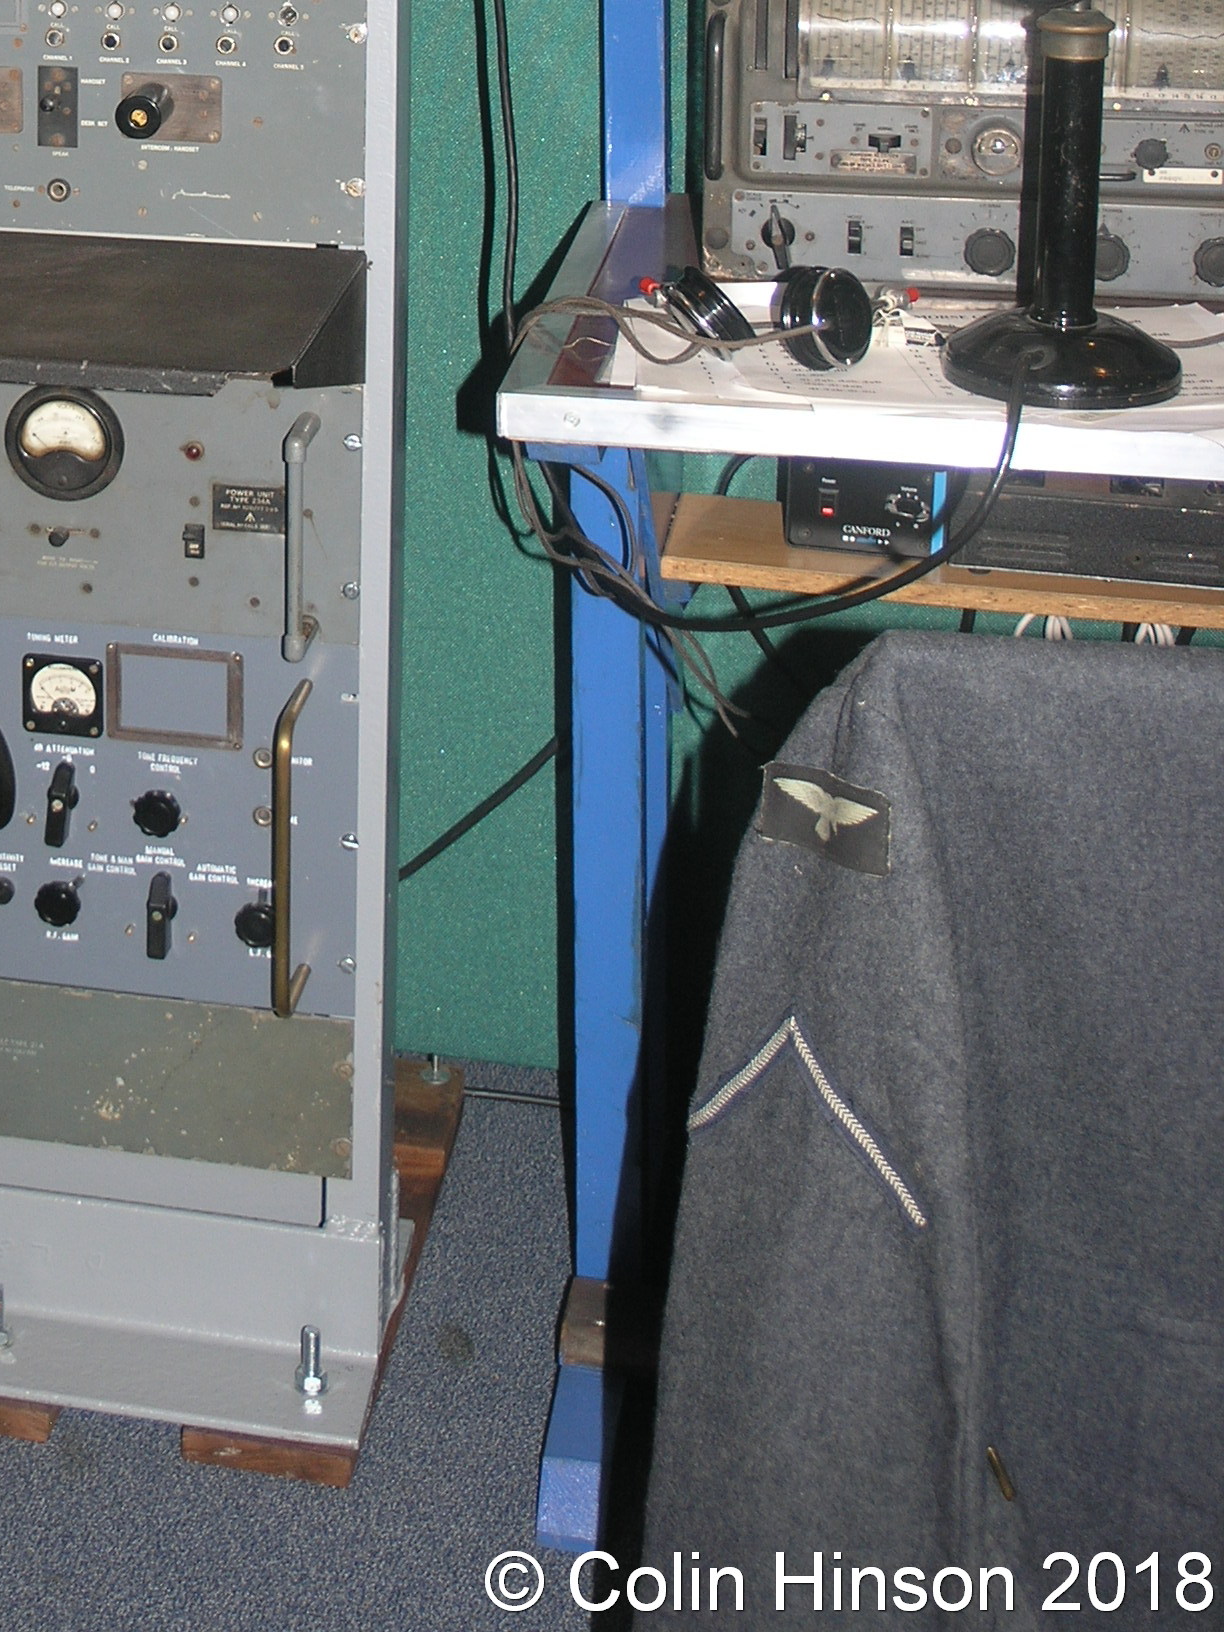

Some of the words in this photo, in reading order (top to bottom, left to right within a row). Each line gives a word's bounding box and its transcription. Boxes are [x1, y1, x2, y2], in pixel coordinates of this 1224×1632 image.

[225, 489, 254, 497] POWER
[256, 490, 275, 498] UNIT
[842, 524, 892, 537] CANFORD
[54, 634, 78, 644] METER
[152, 633, 199, 646] CALIBRATION
[46, 743, 95, 756] ATTENUATION
[157, 753, 198, 765] FREQUENCY
[150, 763, 180, 774] CONTROL
[145, 845, 175, 856] MANUAL
[154, 855, 186, 868] CONTROL
[106, 864, 137, 876] CONTROL
[196, 863, 237, 875] AUTOMATIC
[207, 873, 240, 885] CONTROL
